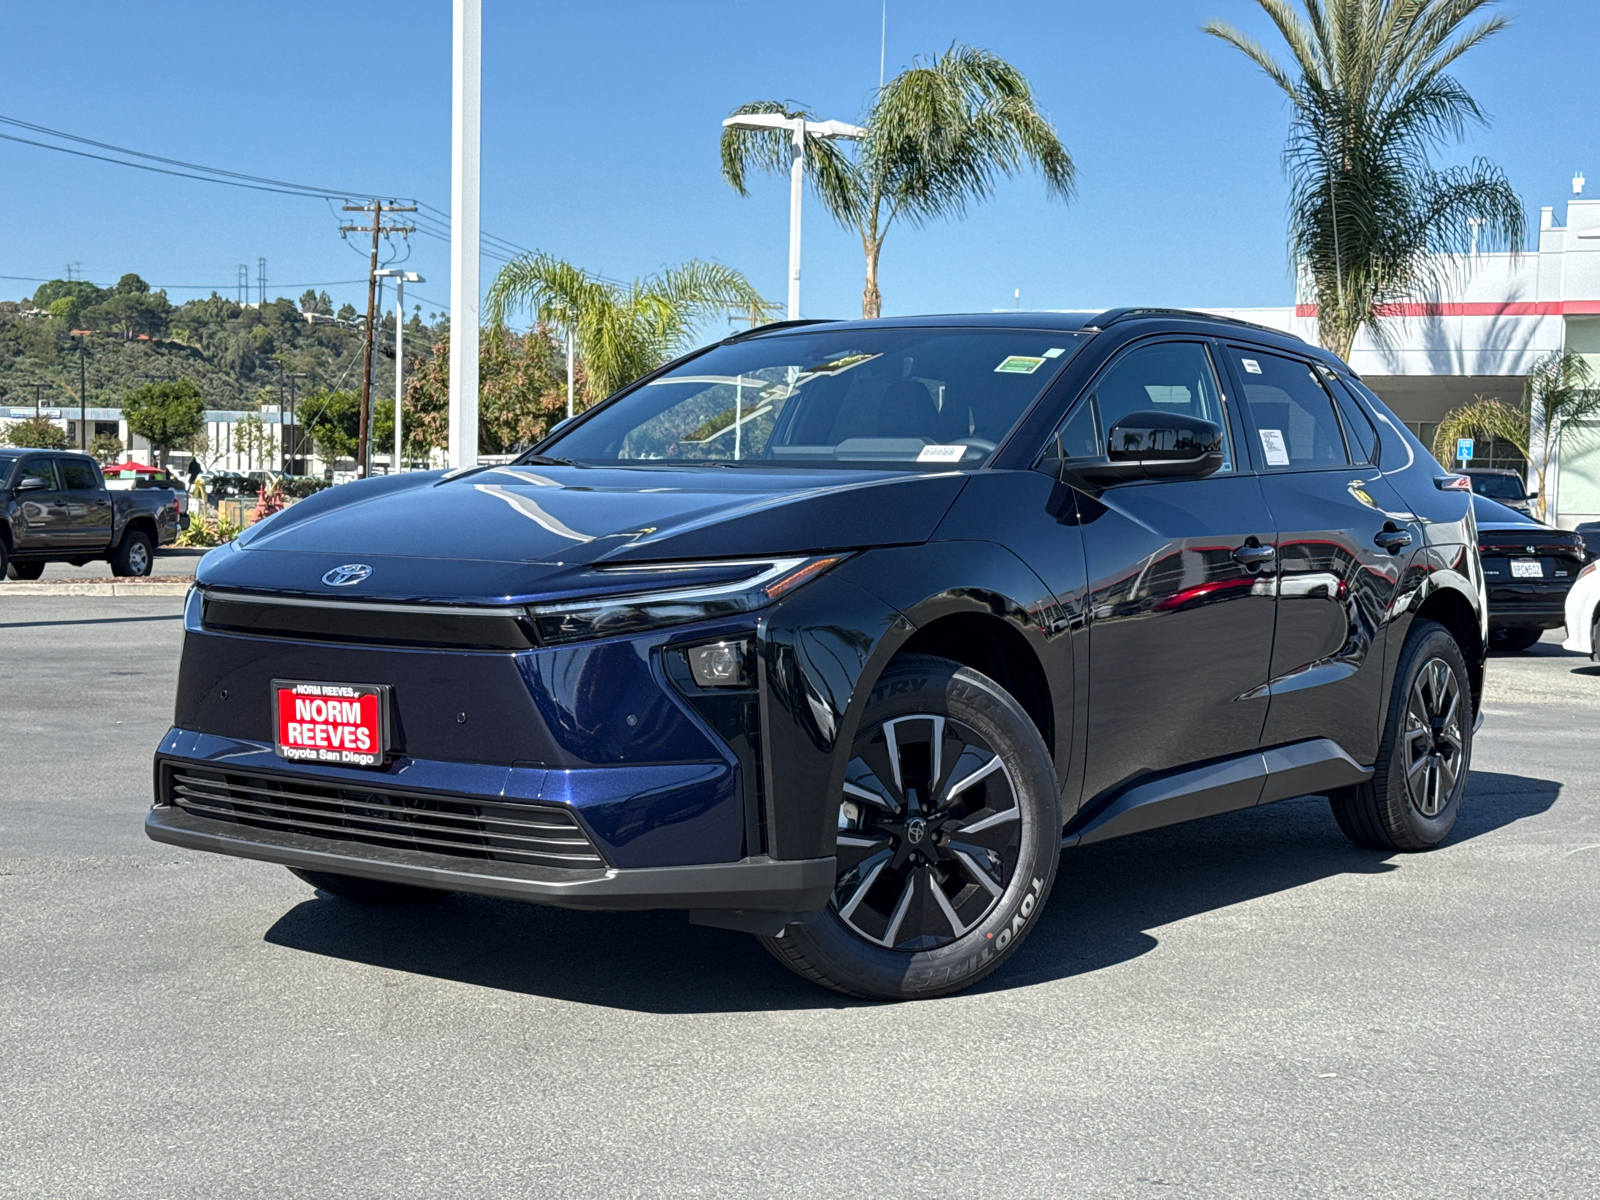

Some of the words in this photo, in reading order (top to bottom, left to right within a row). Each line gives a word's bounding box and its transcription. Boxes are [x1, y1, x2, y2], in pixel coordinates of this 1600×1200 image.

[297, 684, 321, 695] NORM
[323, 686, 354, 698] REEVES
[295, 698, 361, 724] NORM
[287, 722, 371, 750] REEVES
[281, 746, 317, 760] Toyota
[319, 748, 340, 761] San
[342, 751, 374, 765] Diego
[995, 876, 1044, 952] TOYO
